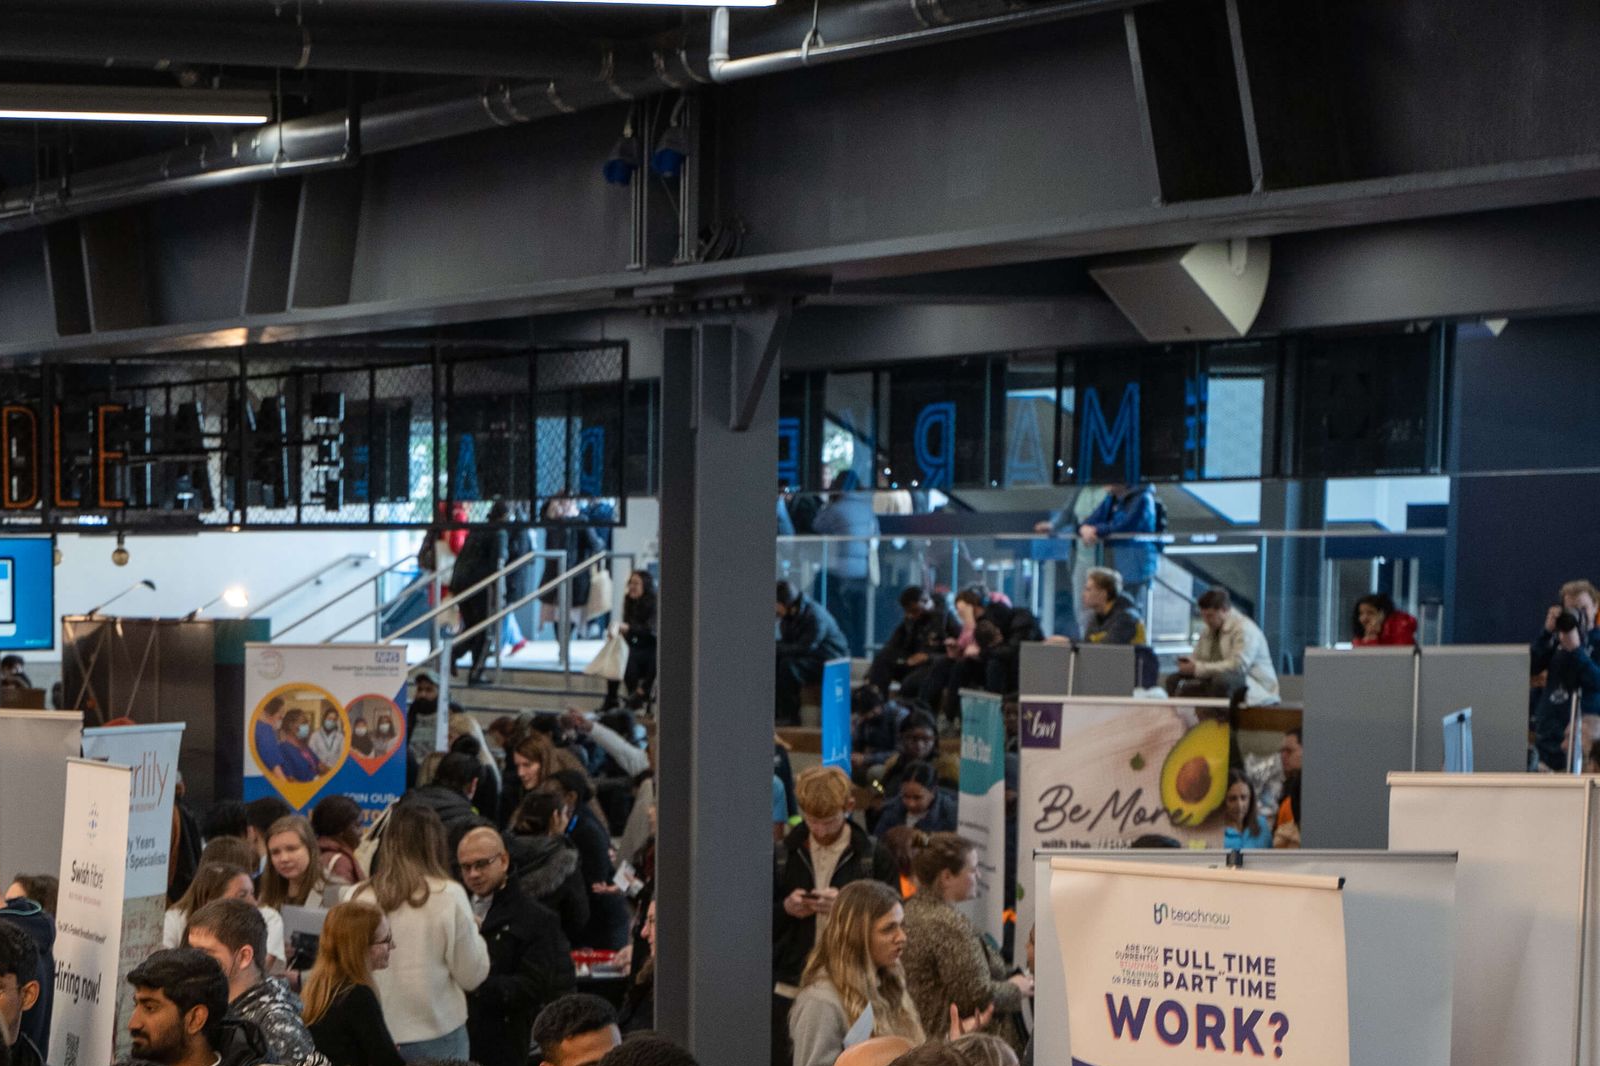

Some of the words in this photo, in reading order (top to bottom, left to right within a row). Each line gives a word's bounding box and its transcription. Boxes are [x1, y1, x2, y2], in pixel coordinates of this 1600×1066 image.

[1034, 784, 1092, 834] Be
[1087, 787, 1194, 834] More
[1142, 945, 1159, 954] YOU
[1163, 947, 1215, 971] FULL
[1223, 953, 1276, 978] TIME
[53, 960, 81, 1005] Hiring
[81, 972, 102, 1005] now!
[1163, 971, 1218, 994] PART
[1225, 977, 1277, 1001] TIME
[1104, 992, 1290, 1060] WORK?
